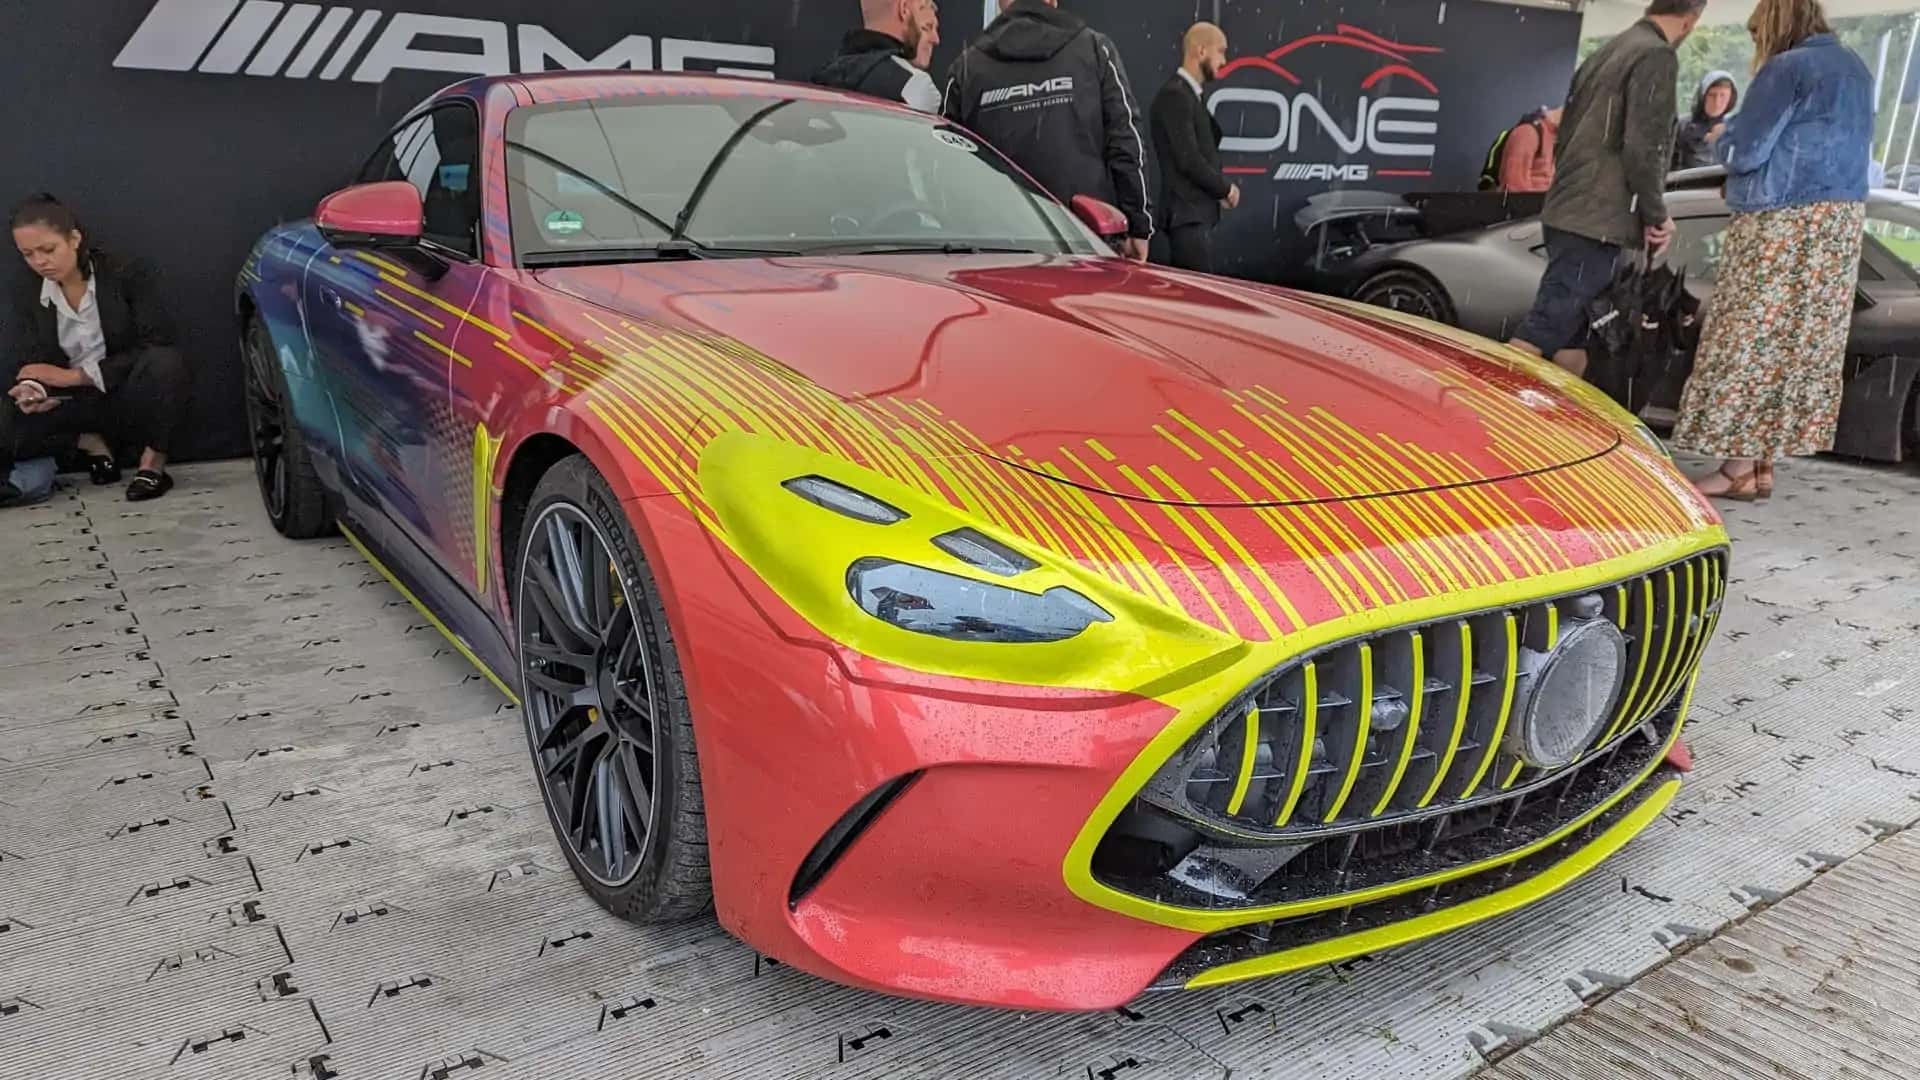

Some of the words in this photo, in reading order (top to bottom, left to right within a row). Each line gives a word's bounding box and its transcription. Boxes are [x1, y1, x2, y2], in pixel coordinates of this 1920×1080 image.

[1005, 77, 1072, 99] AMG
[1207, 87, 1440, 156] ONE
[1303, 164, 1369, 181] AMG
[599, 506, 644, 600] MICHELIN
